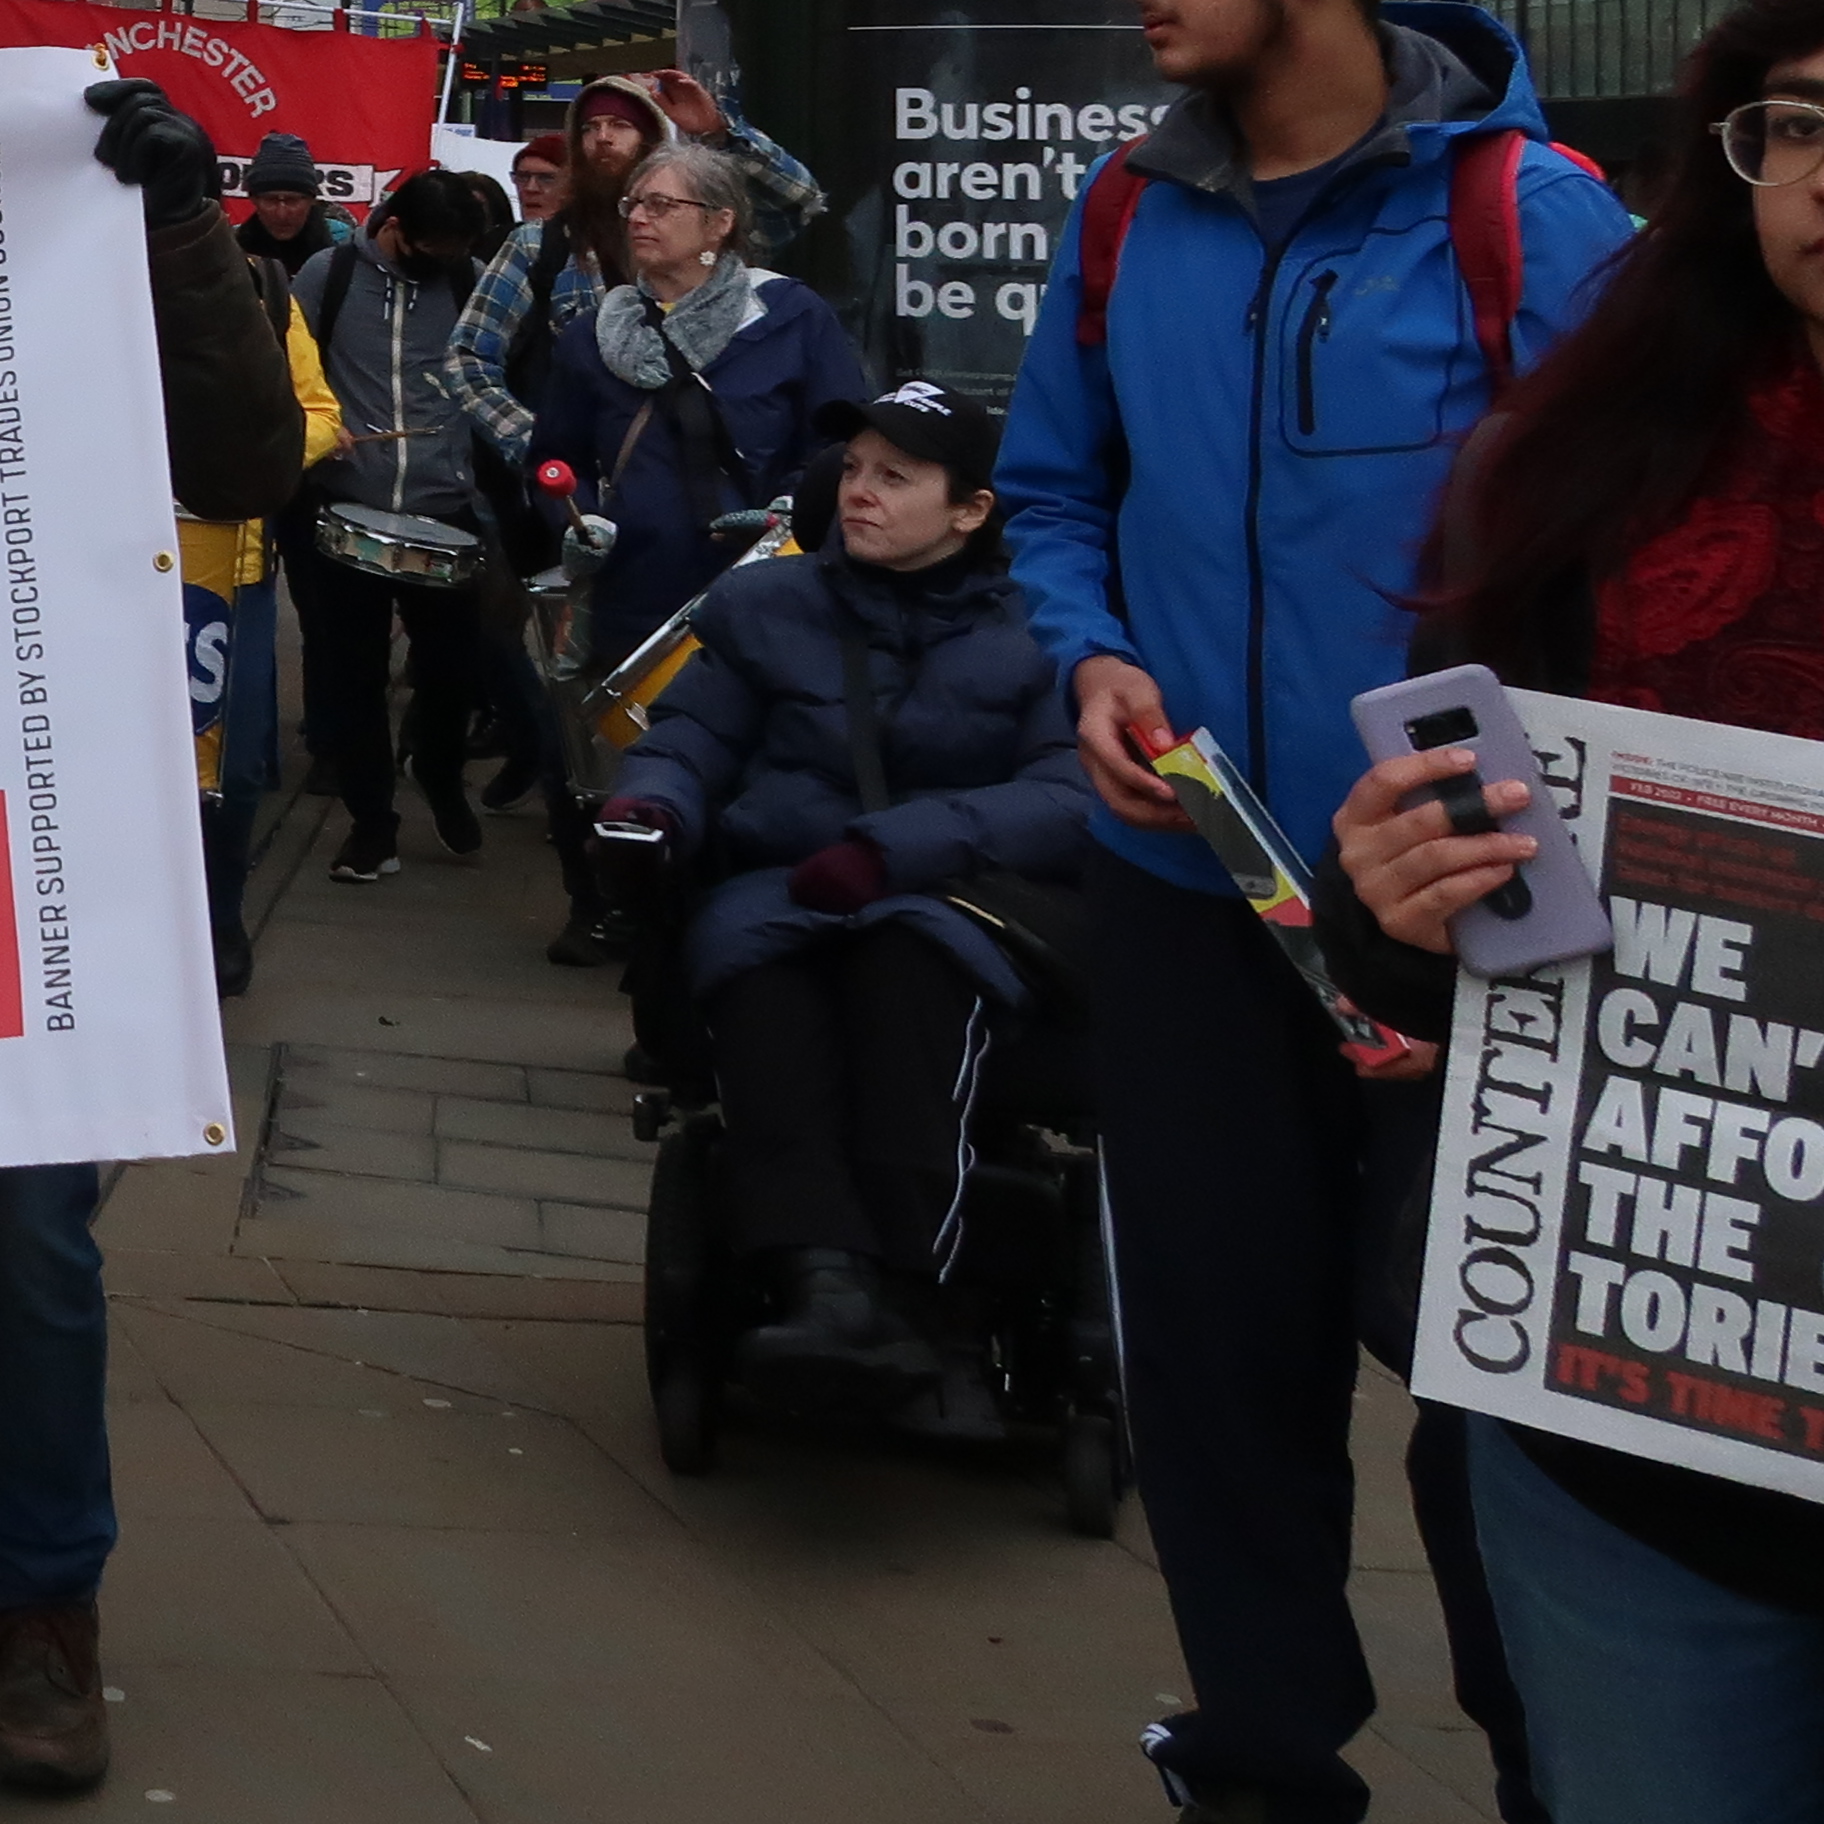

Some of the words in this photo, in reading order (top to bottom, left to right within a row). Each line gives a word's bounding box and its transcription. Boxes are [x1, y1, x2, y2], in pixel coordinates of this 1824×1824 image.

[102, 19, 278, 119] NCHESTER
[892, 146, 1086, 202] aren't
[895, 203, 1050, 261] born
[895, 262, 976, 319] be
[1, 491, 44, 662] STOCKPORT
[19, 670, 49, 708] BY
[23, 714, 66, 896] SUPPORTED
[39, 903, 76, 1034] BANNER
[1609, 894, 1754, 1003] WE
[1596, 987, 1824, 1103] CAN'
[1580, 1074, 1824, 1203] AFFO
[1577, 1161, 1763, 1284] THE
[1567, 1250, 1824, 1397] TORIE
[1554, 1341, 1650, 1404] IT'S
[1665, 1365, 1789, 1439] TIME
